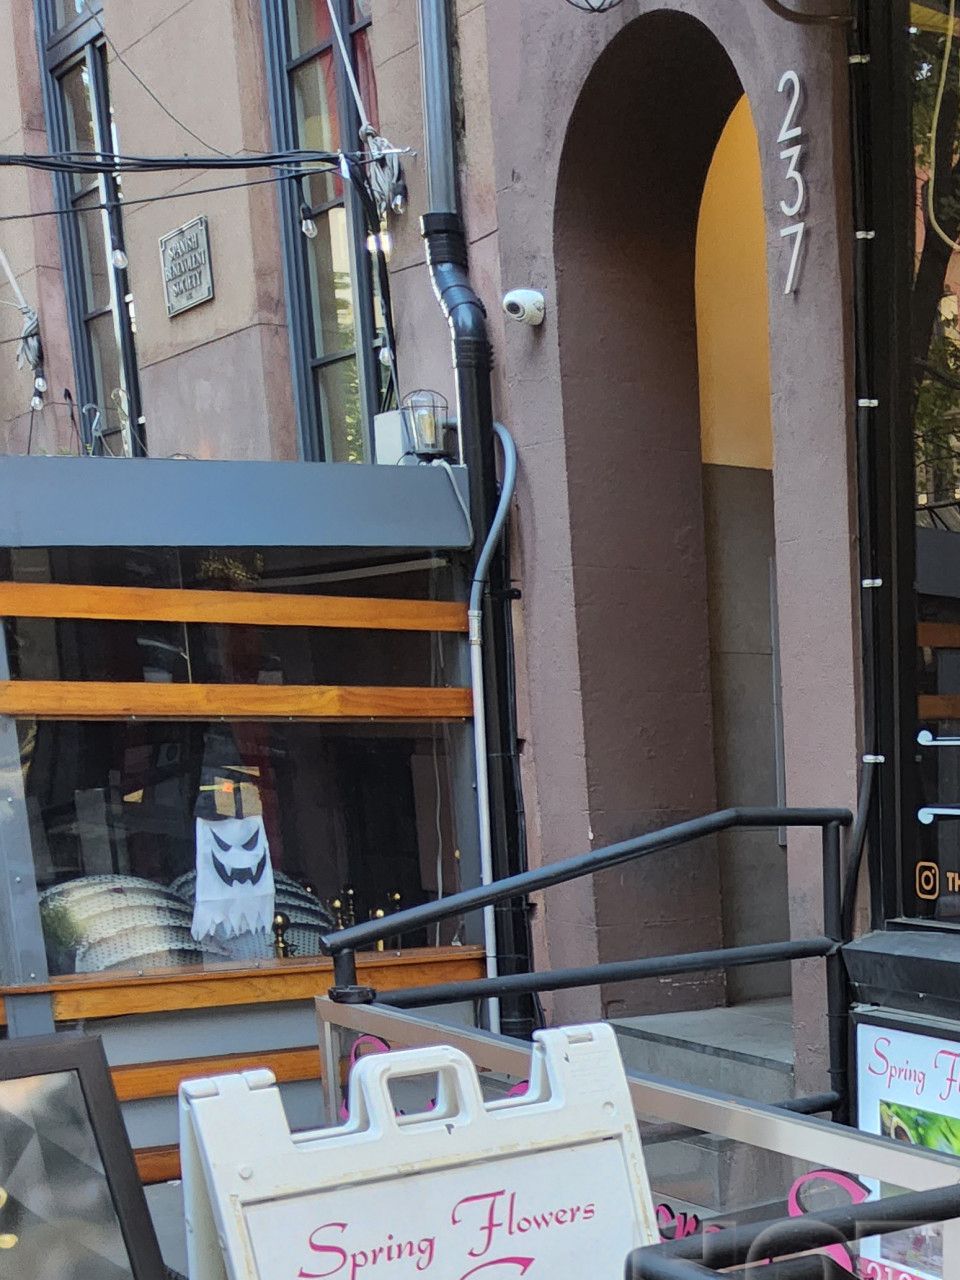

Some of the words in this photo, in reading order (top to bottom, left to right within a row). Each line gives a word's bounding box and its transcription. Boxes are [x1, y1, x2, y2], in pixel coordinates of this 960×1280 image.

[777, 69, 805, 295] 237
[866, 1036, 927, 1096] Spring
[450, 1188, 596, 1259] Flowers
